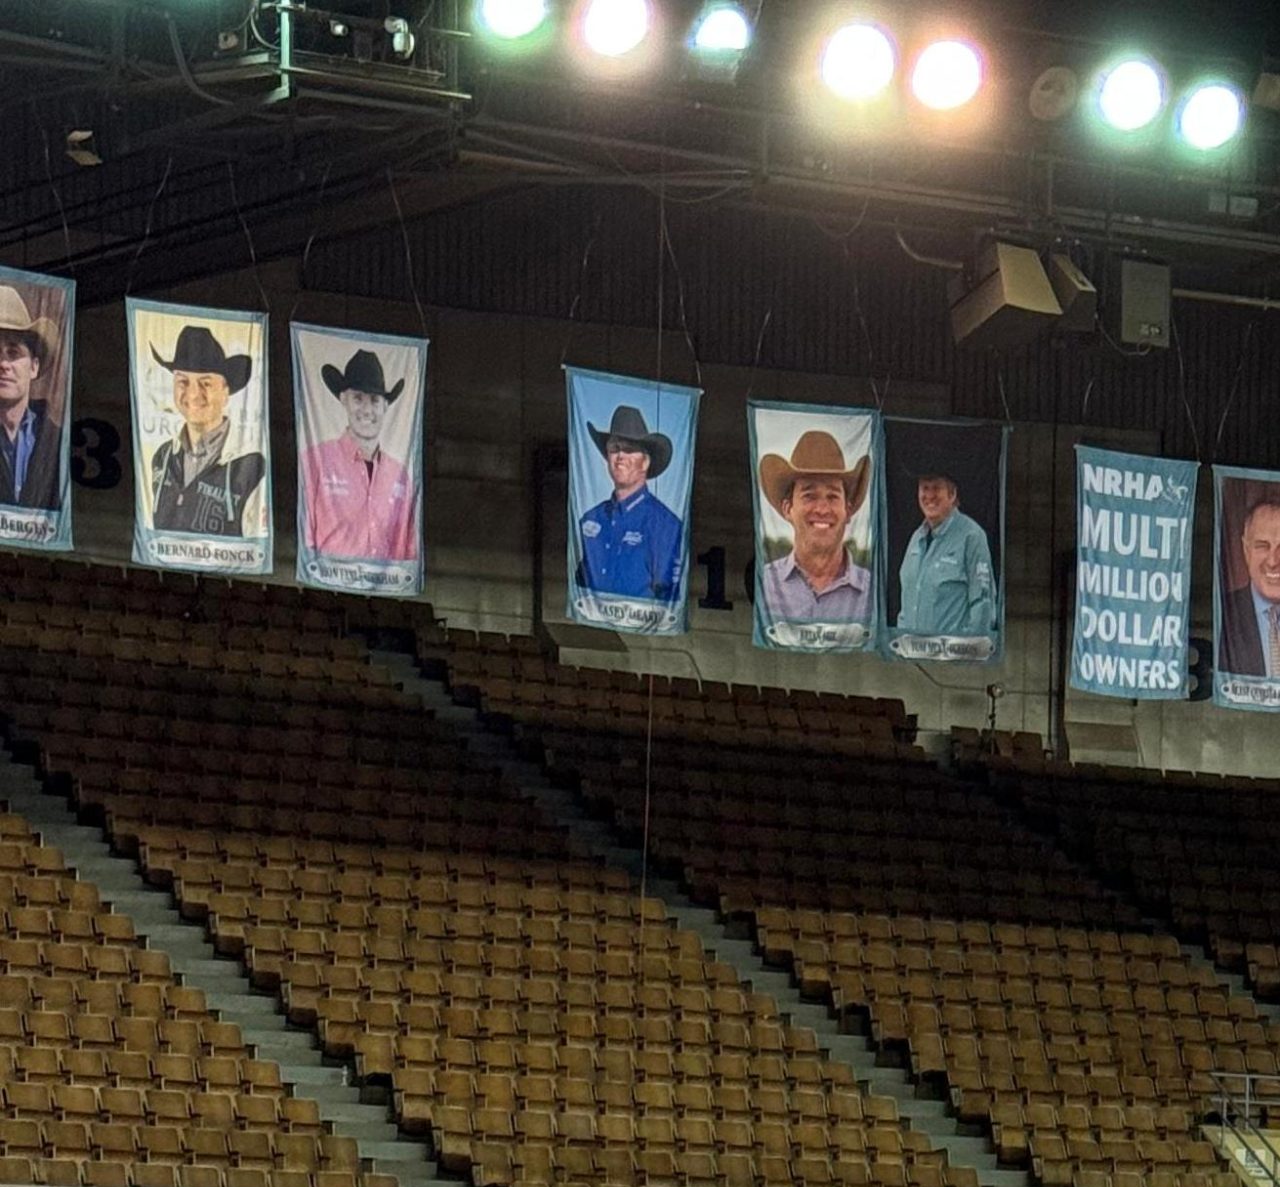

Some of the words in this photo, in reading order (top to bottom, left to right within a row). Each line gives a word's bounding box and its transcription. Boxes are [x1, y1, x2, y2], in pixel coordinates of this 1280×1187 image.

[1083, 463, 1164, 500] NRHA
[1081, 504, 1187, 560] MULTI
[157, 542, 211, 561] BERNARD
[214, 547, 255, 562] FONCK
[1079, 560, 1183, 602] MILLION
[1081, 606, 1183, 647] DOLLAR
[1080, 653, 1181, 690] OWNERS
